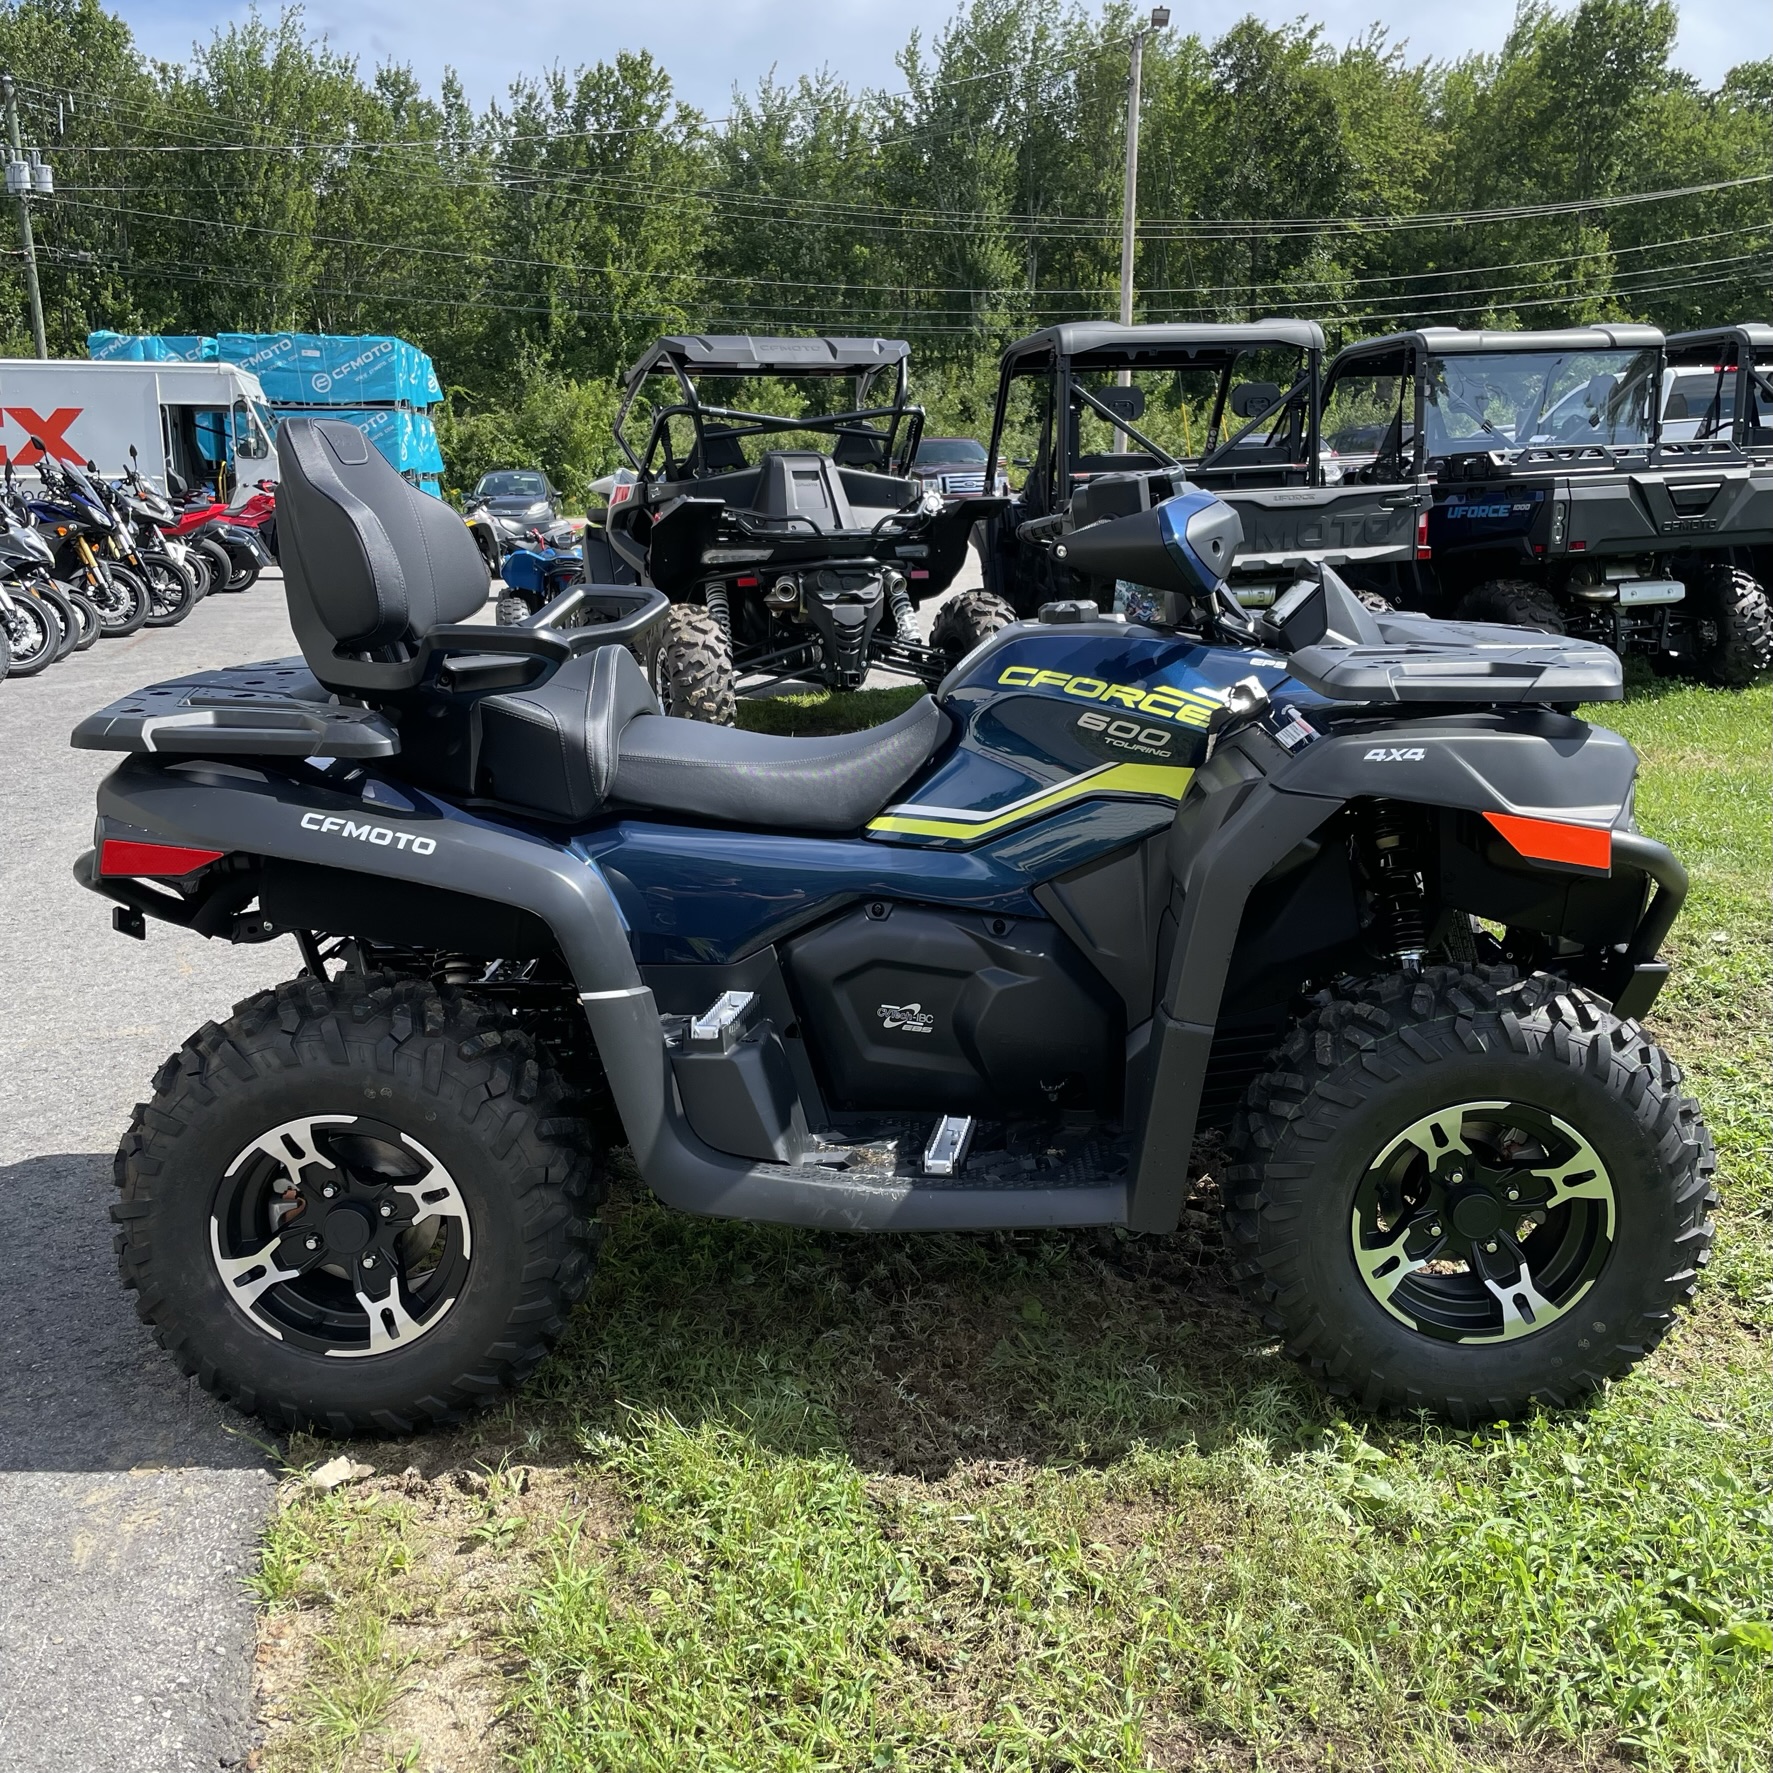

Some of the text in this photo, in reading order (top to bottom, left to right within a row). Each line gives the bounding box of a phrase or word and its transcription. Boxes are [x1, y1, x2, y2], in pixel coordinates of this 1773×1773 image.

[234, 339, 292, 370] FMOTO
[331, 341, 392, 380] CFMOTO
[759, 344, 821, 352] CFMOTO
[0, 408, 88, 466] X
[1447, 505, 1511, 519] UFORCE
[1661, 518, 1718, 532] CFMOTO
[1249, 657, 1288, 670] EPS
[997, 666, 1223, 728] CFORCE
[1077, 712, 1171, 747] 600
[1104, 737, 1172, 758] TOURING
[300, 812, 437, 855] CFMOTO
